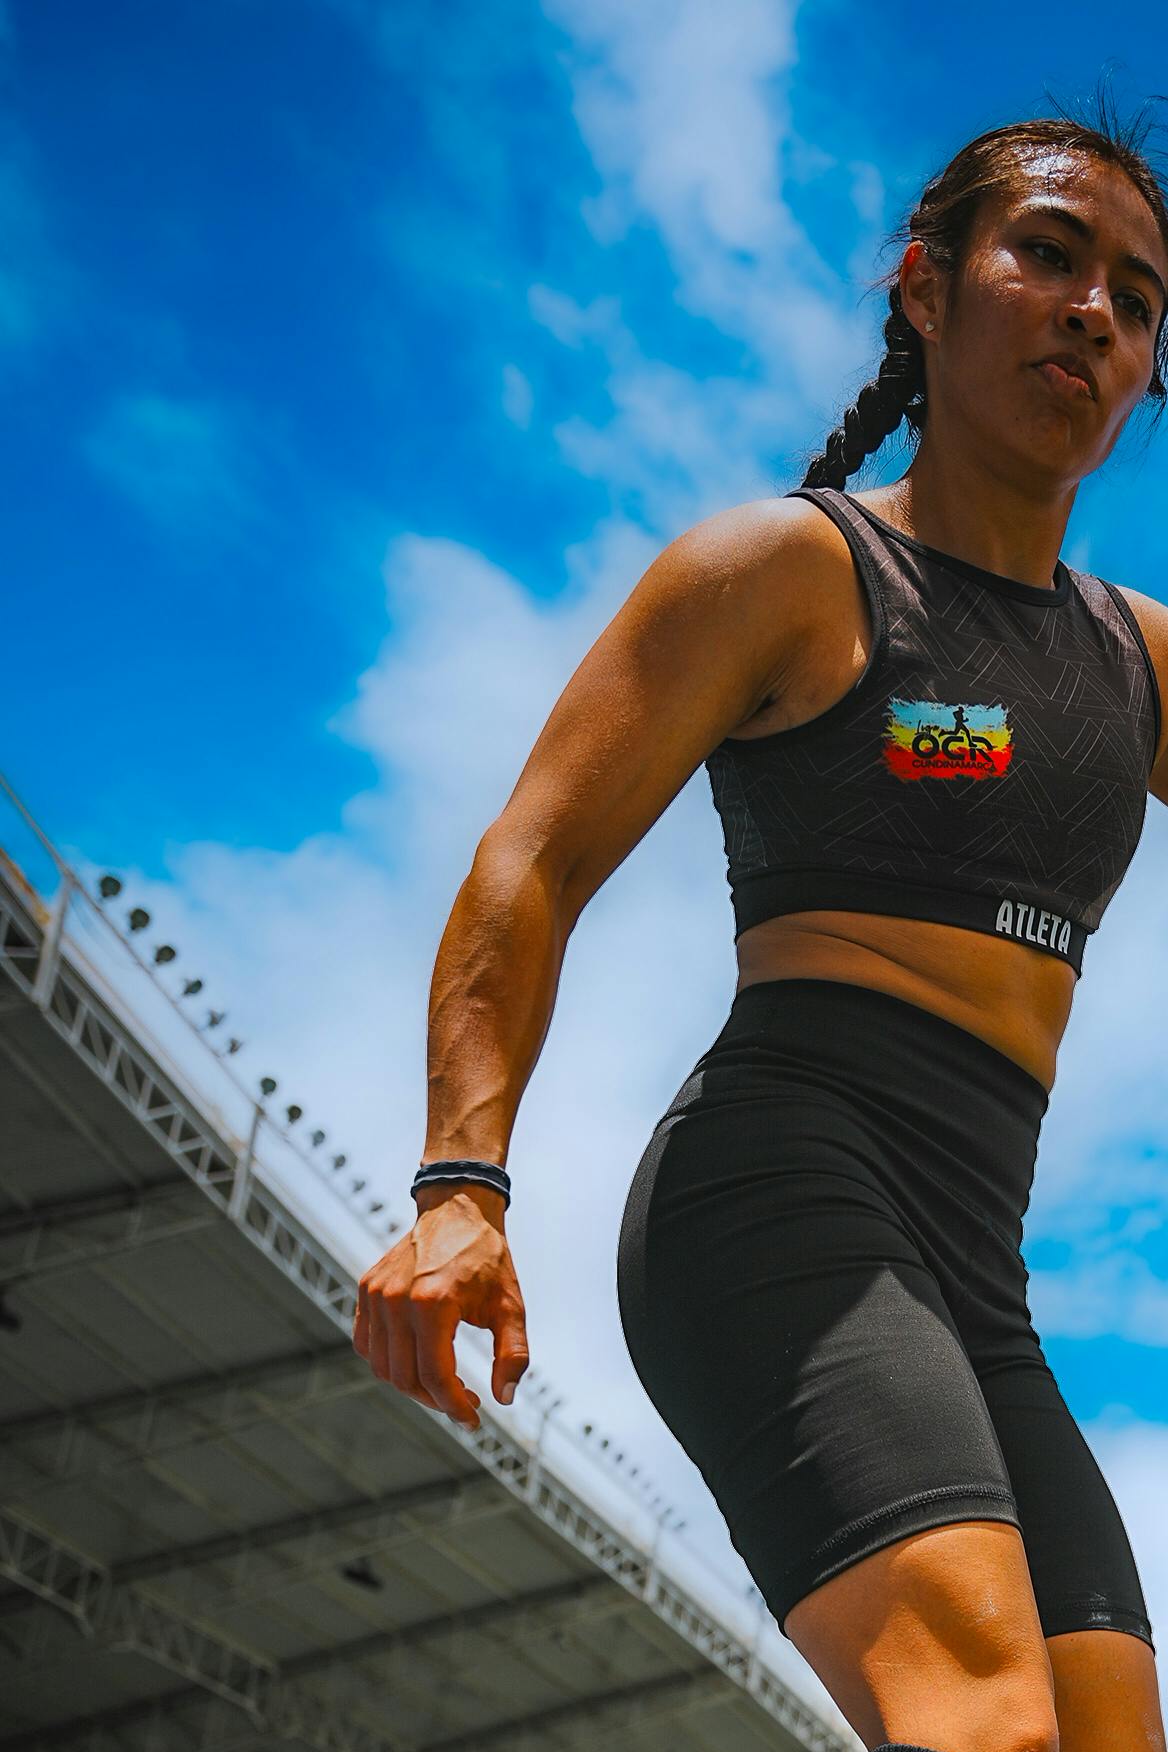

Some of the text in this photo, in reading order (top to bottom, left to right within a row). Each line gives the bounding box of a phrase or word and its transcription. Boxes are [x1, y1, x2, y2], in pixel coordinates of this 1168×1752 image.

[912, 734, 995, 762] OCR
[912, 759, 997, 773] CUNDINAMARCA
[995, 899, 1071, 955] ATLETA
